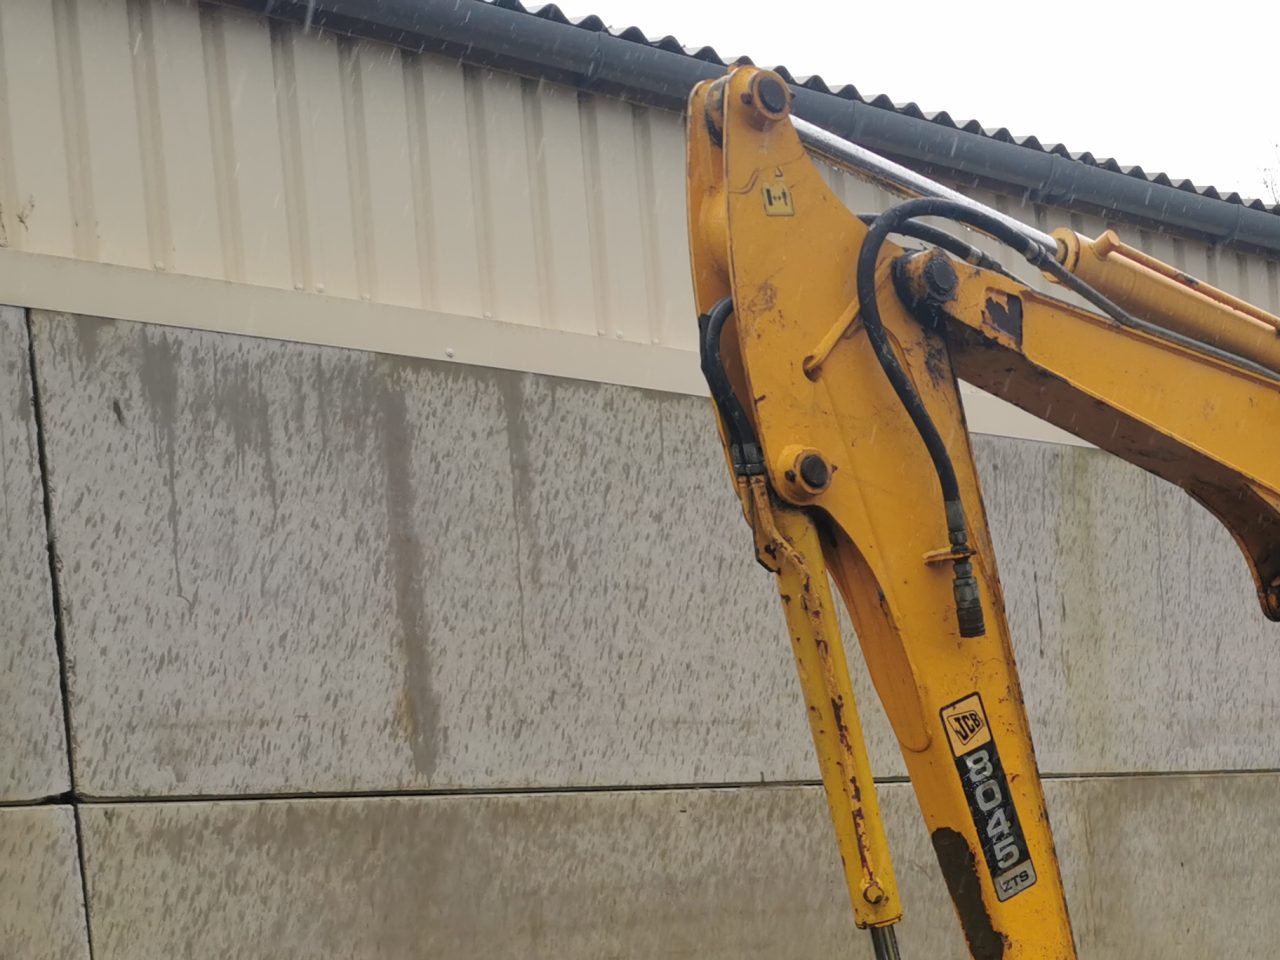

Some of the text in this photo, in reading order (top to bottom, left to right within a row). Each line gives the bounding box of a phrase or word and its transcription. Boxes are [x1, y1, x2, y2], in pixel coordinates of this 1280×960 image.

[953, 711, 981, 741] JCB
[965, 749, 1020, 869] 8045
[1002, 870, 1030, 892] ZTS
